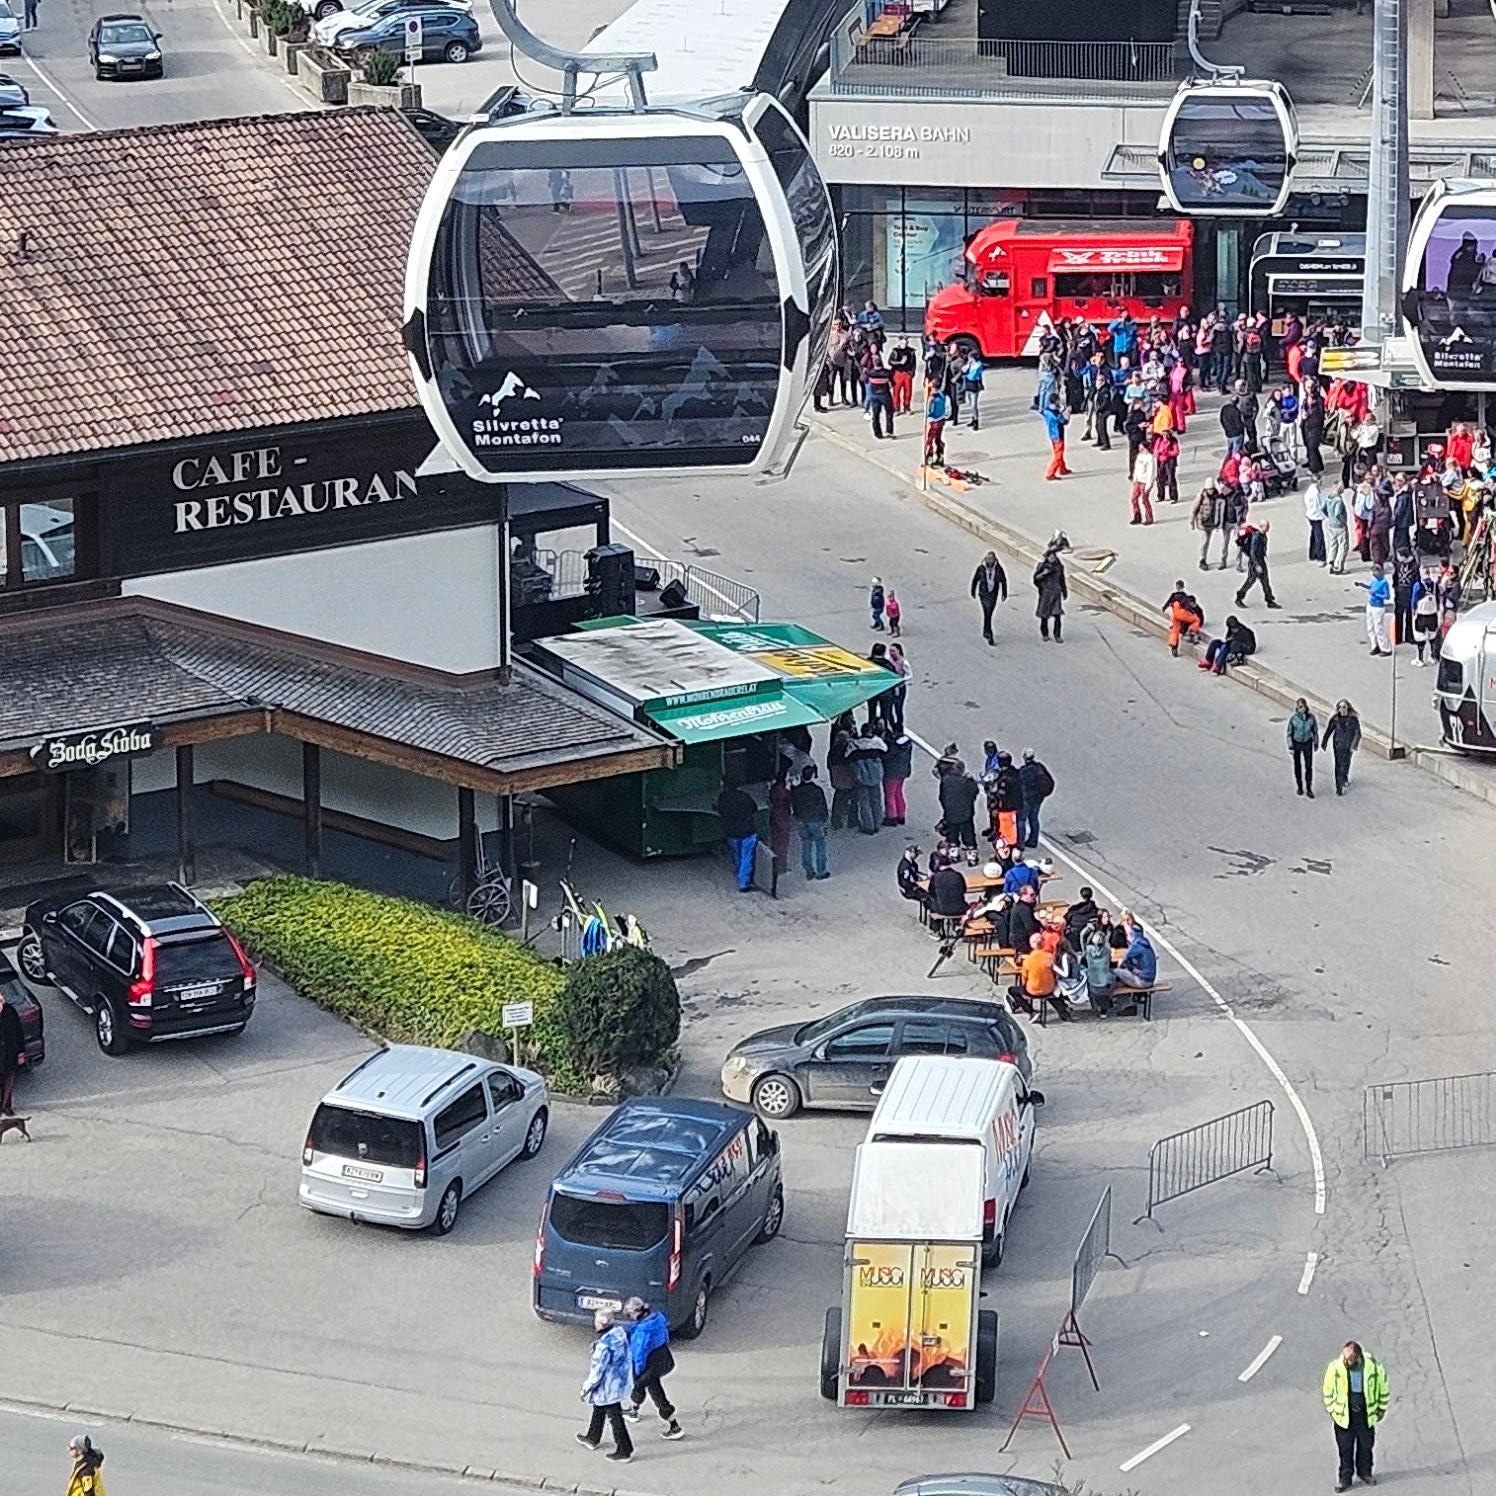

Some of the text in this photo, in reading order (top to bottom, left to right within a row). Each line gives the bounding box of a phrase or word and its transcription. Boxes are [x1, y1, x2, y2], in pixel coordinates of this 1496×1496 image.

[828, 125, 971, 142] VALISERA BAHN
[828, 144, 854, 157] 820
[906, 147, 920, 159] m
[472, 416, 564, 432] Silvretta
[474, 432, 562, 446] Montafon
[172, 446, 283, 490] CAFE
[173, 468, 419, 534] RESTAURAN
